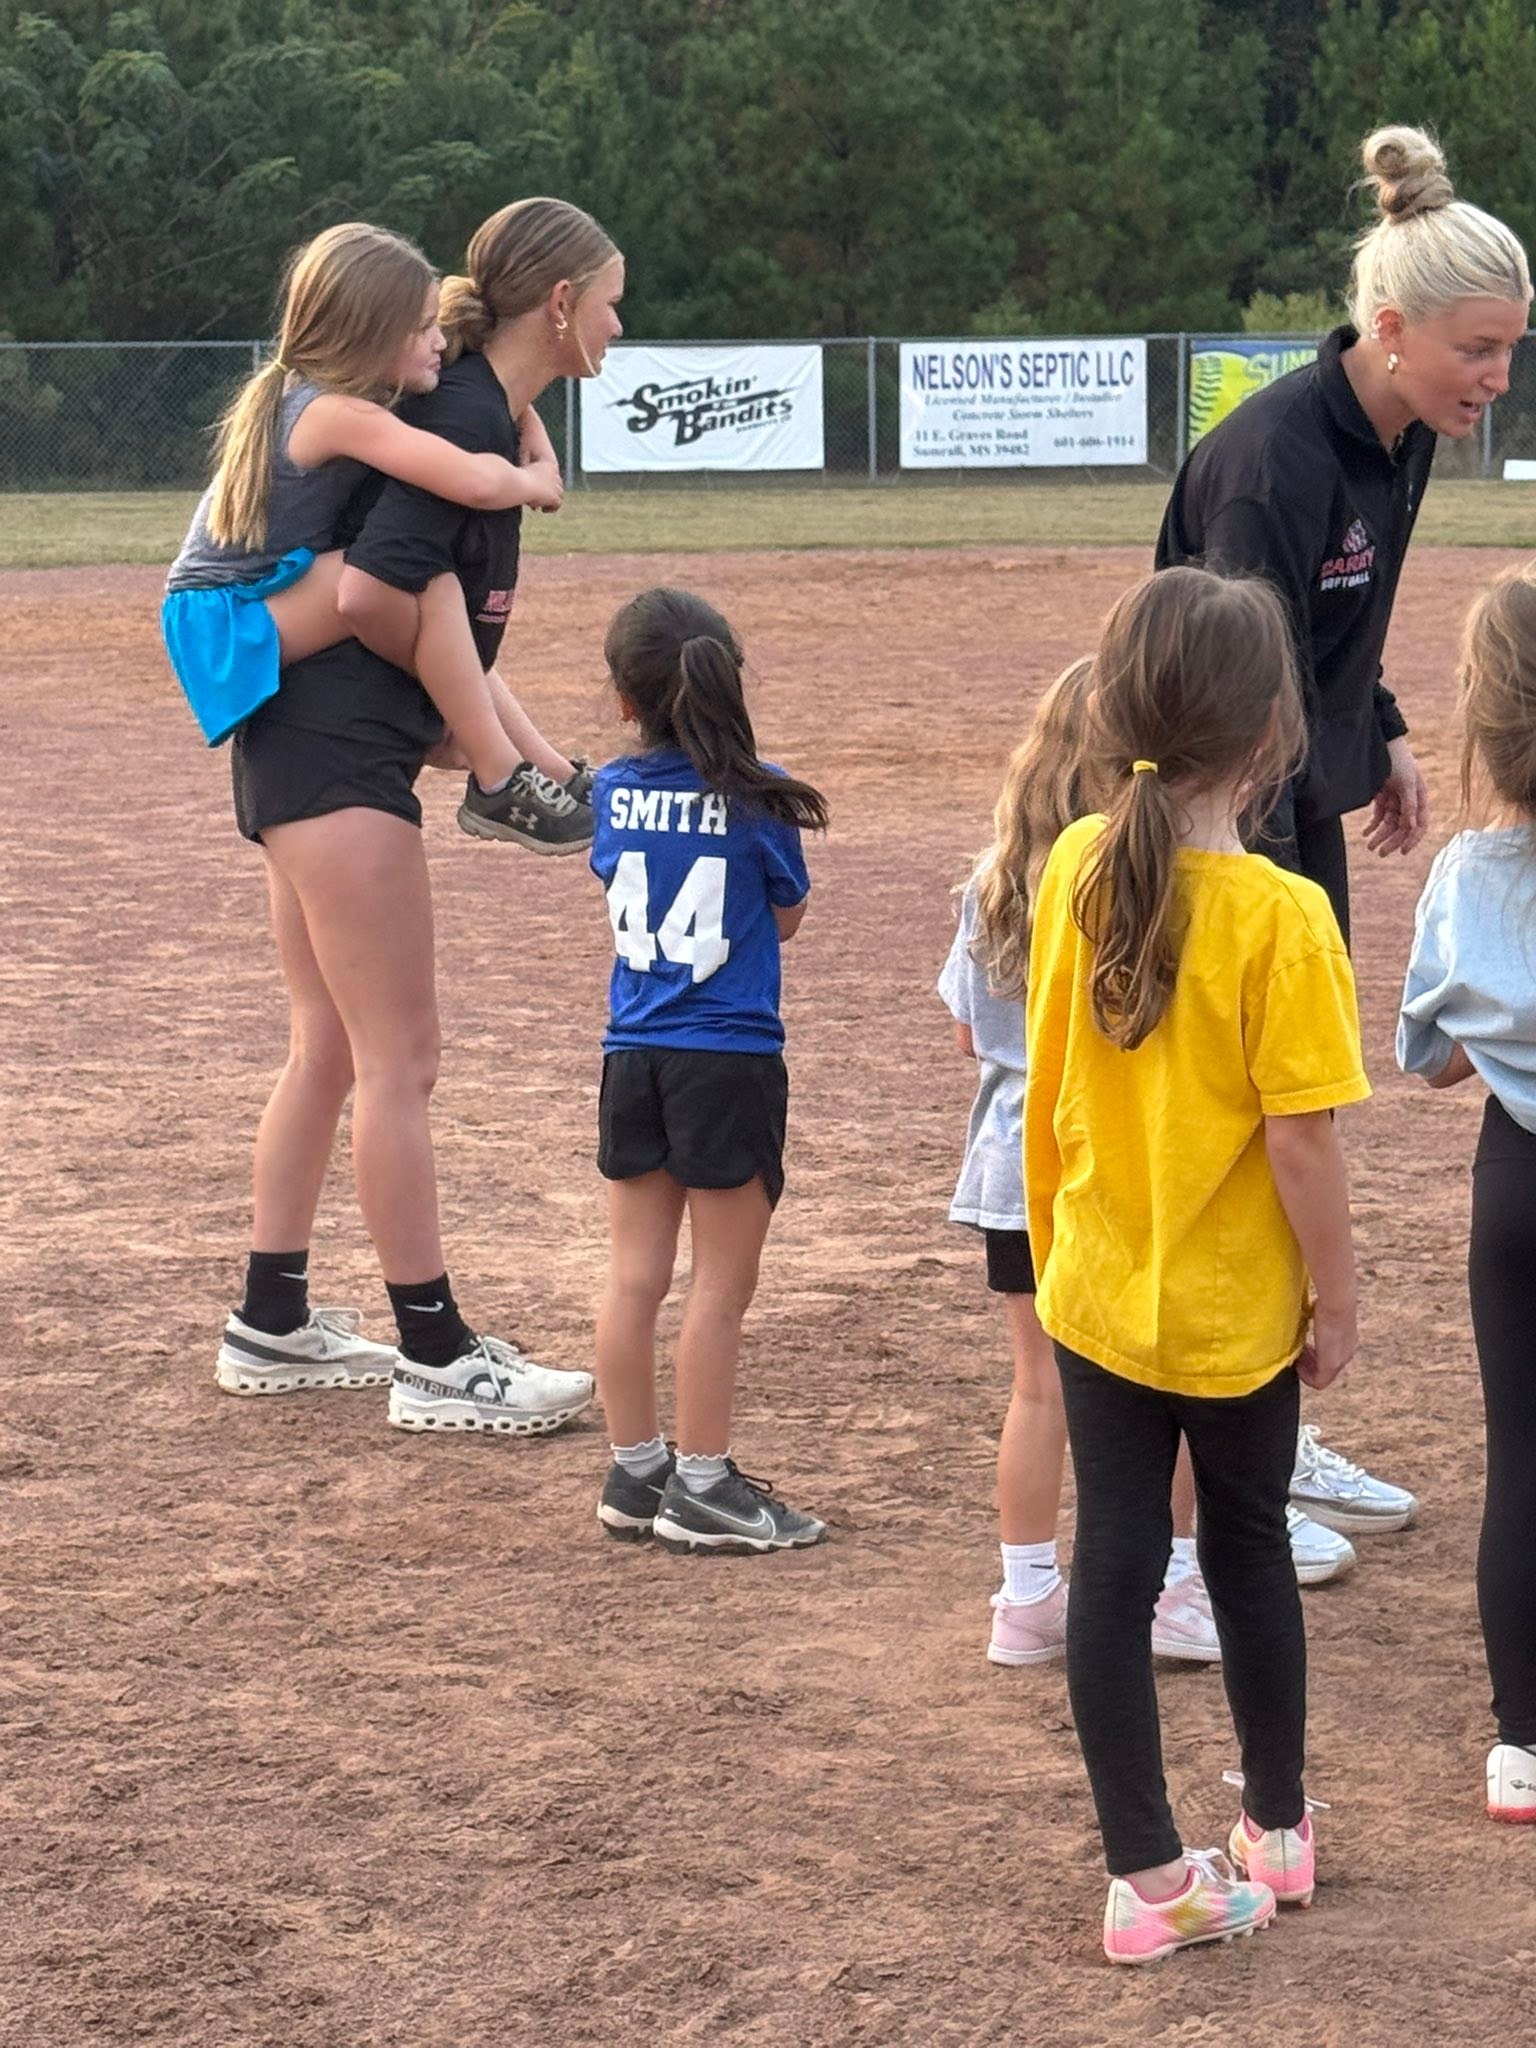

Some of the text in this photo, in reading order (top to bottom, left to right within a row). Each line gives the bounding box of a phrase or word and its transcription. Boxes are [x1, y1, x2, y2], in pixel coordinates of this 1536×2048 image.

[913, 350, 1135, 390] NELSON'S SEPTIC LLC
[672, 397, 794, 446] Bandits
[995, 427, 1029, 440] Road
[1320, 570, 1371, 592] SOFTBALL
[610, 788, 729, 836] SMITH
[606, 851, 730, 984] 44
